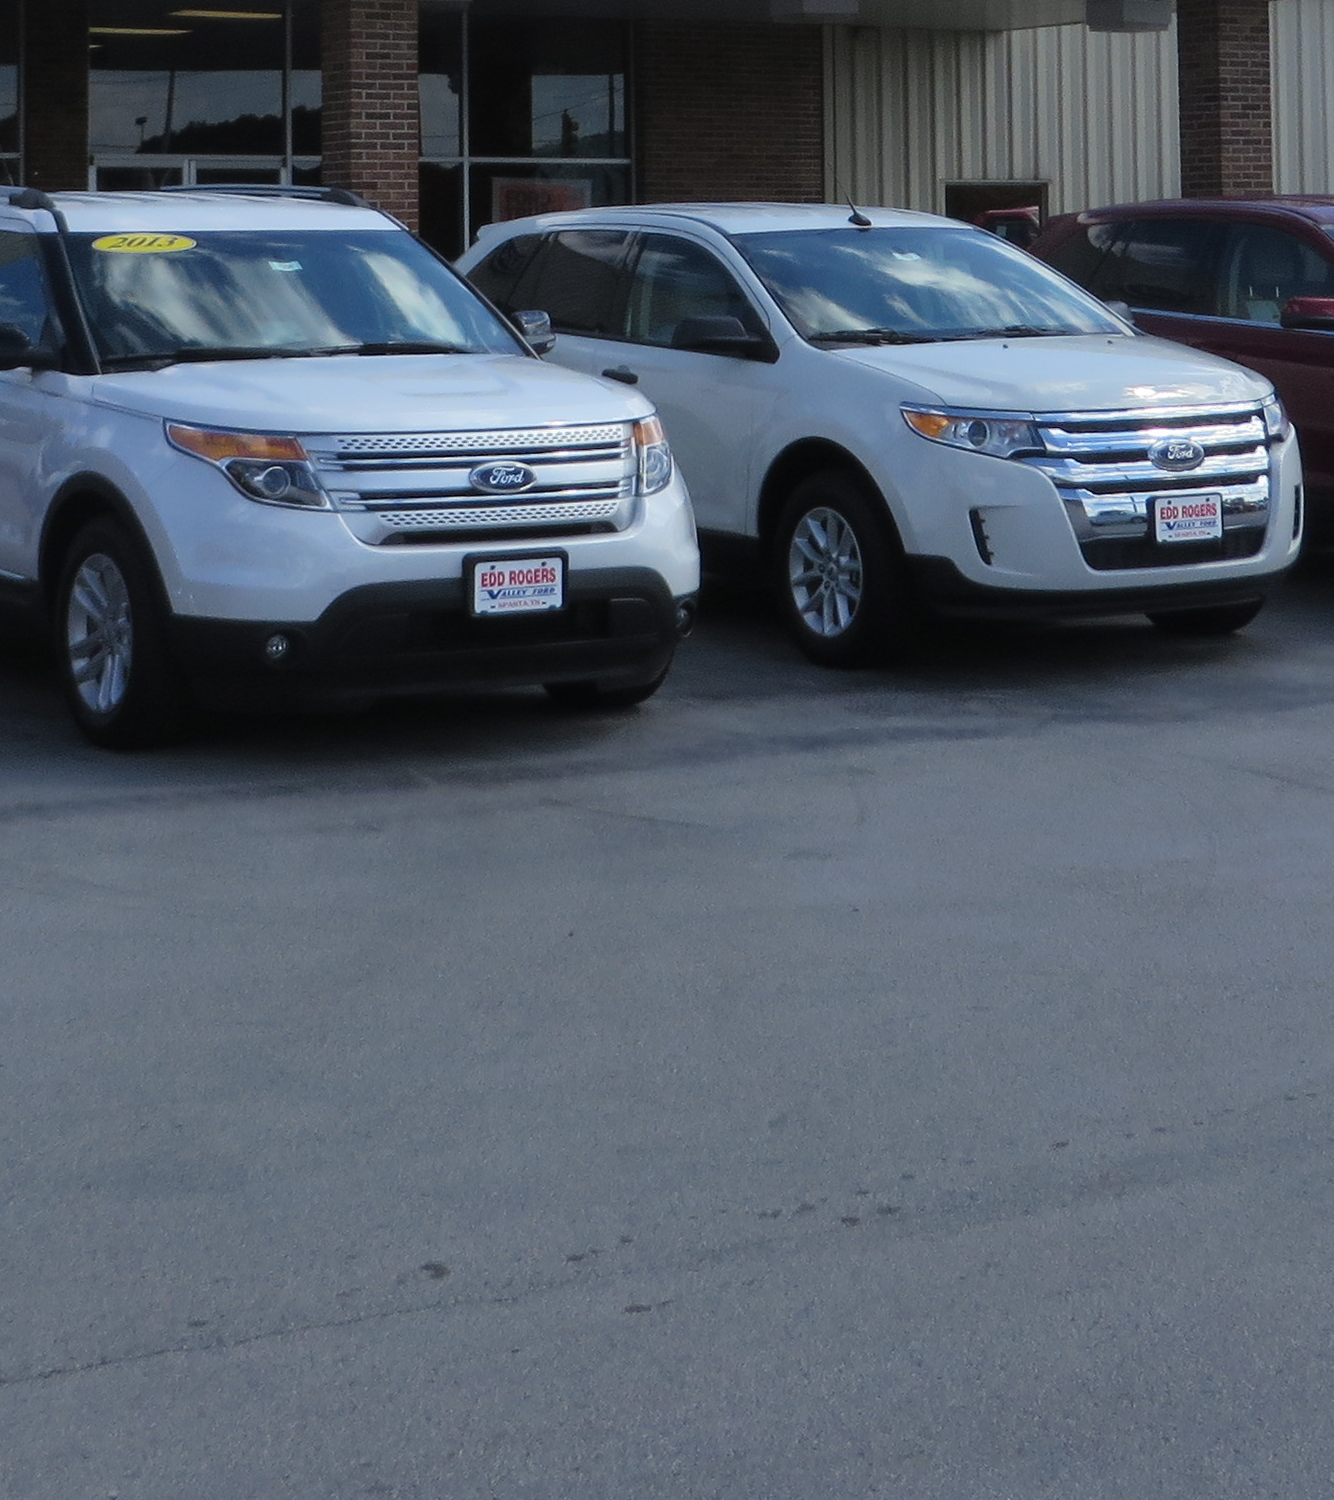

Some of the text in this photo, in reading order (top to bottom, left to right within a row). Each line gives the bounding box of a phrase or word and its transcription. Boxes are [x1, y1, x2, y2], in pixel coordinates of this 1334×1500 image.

[108, 236, 178, 249] 2013
[1167, 444, 1194, 460] Ford
[489, 466, 524, 485] Ford
[1160, 503, 1217, 520] EDD ROGERS
[481, 567, 557, 588] EDD ROGERS
[487, 586, 556, 600] VALLEY FORD
